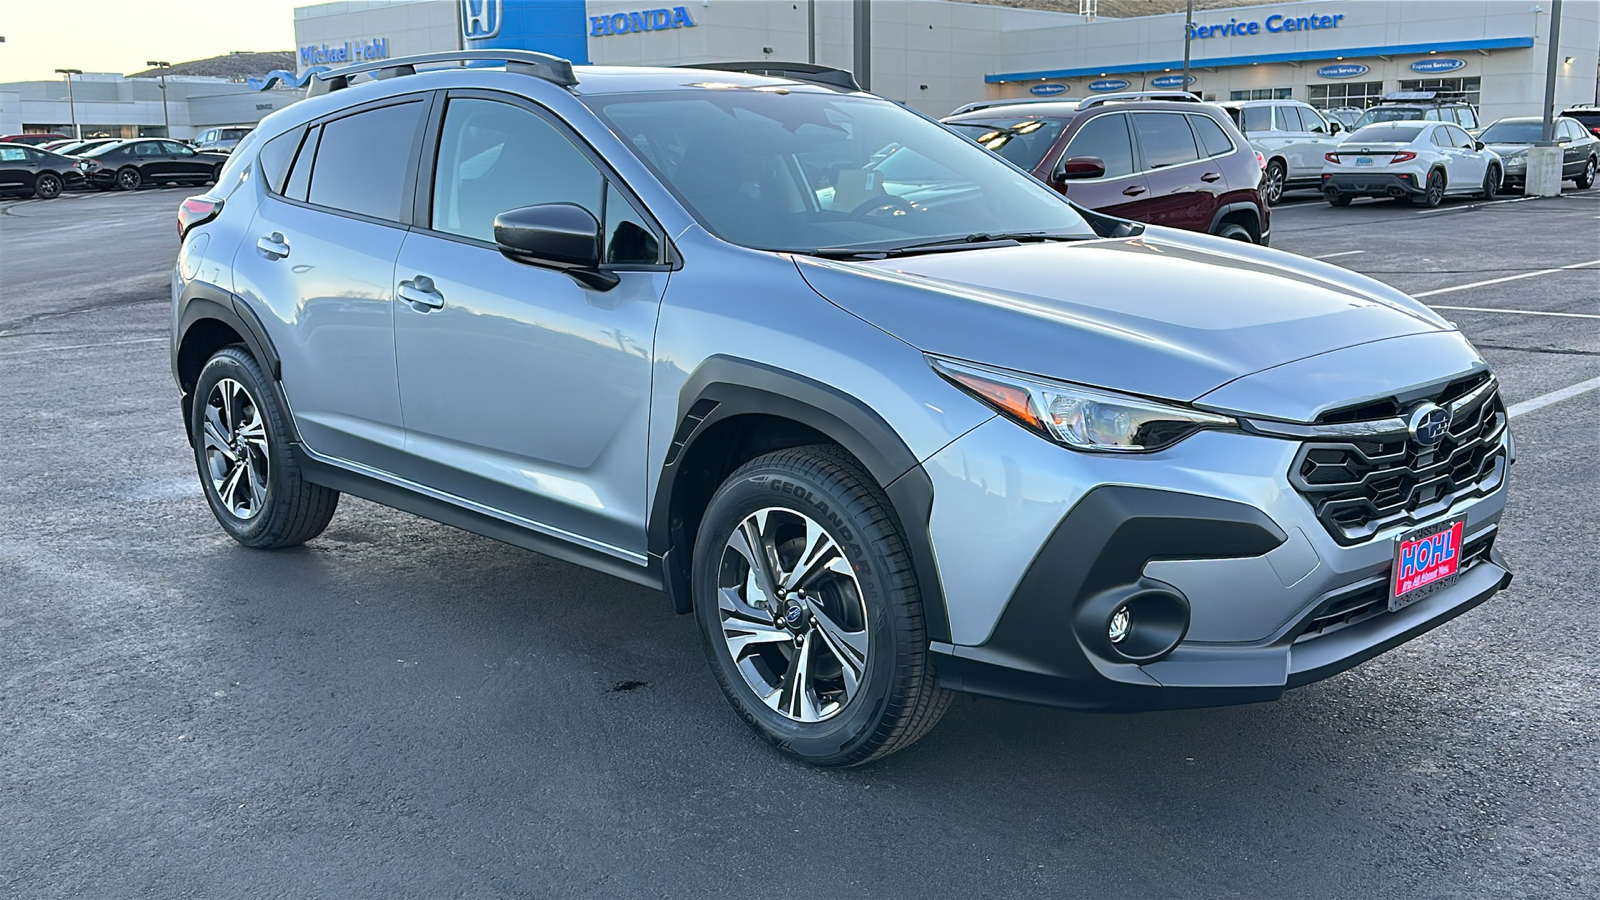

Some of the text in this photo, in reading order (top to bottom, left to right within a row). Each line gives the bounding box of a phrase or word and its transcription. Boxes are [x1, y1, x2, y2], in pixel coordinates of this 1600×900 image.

[589, 6, 695, 37] HONDA
[1185, 13, 1345, 40] Service Center
[300, 37, 387, 66] Michael Hohl
[770, 479, 872, 578] GEOLANDAR
[1400, 530, 1454, 580] HOHL
